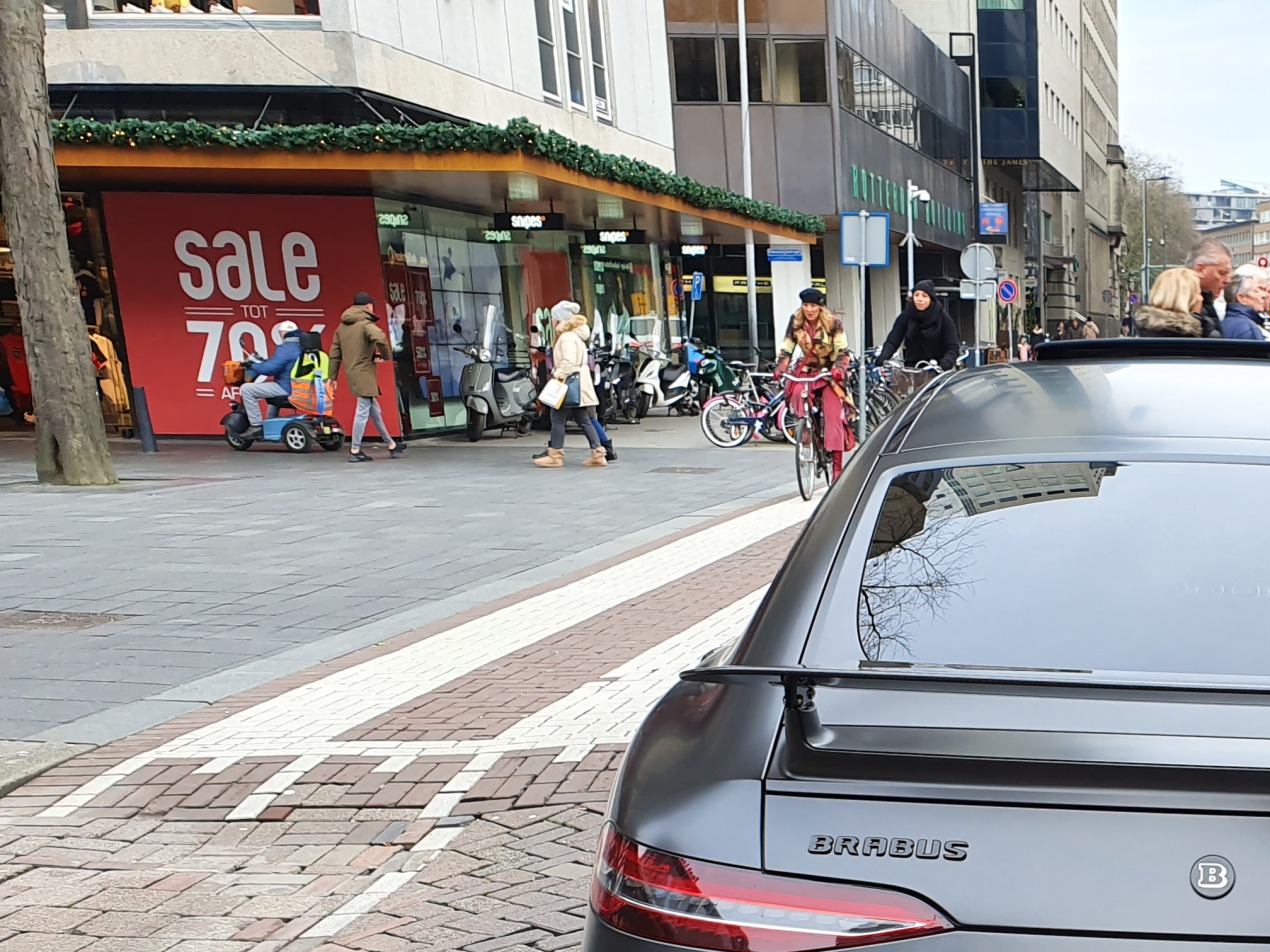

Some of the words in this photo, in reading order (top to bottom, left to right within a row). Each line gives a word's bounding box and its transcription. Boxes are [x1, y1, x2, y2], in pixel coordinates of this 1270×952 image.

[851, 165, 919, 220] ROTTERDM
[240, 304, 269, 318] TOT
[807, 834, 970, 862] BRABUS
[1197, 862, 1228, 889] B
